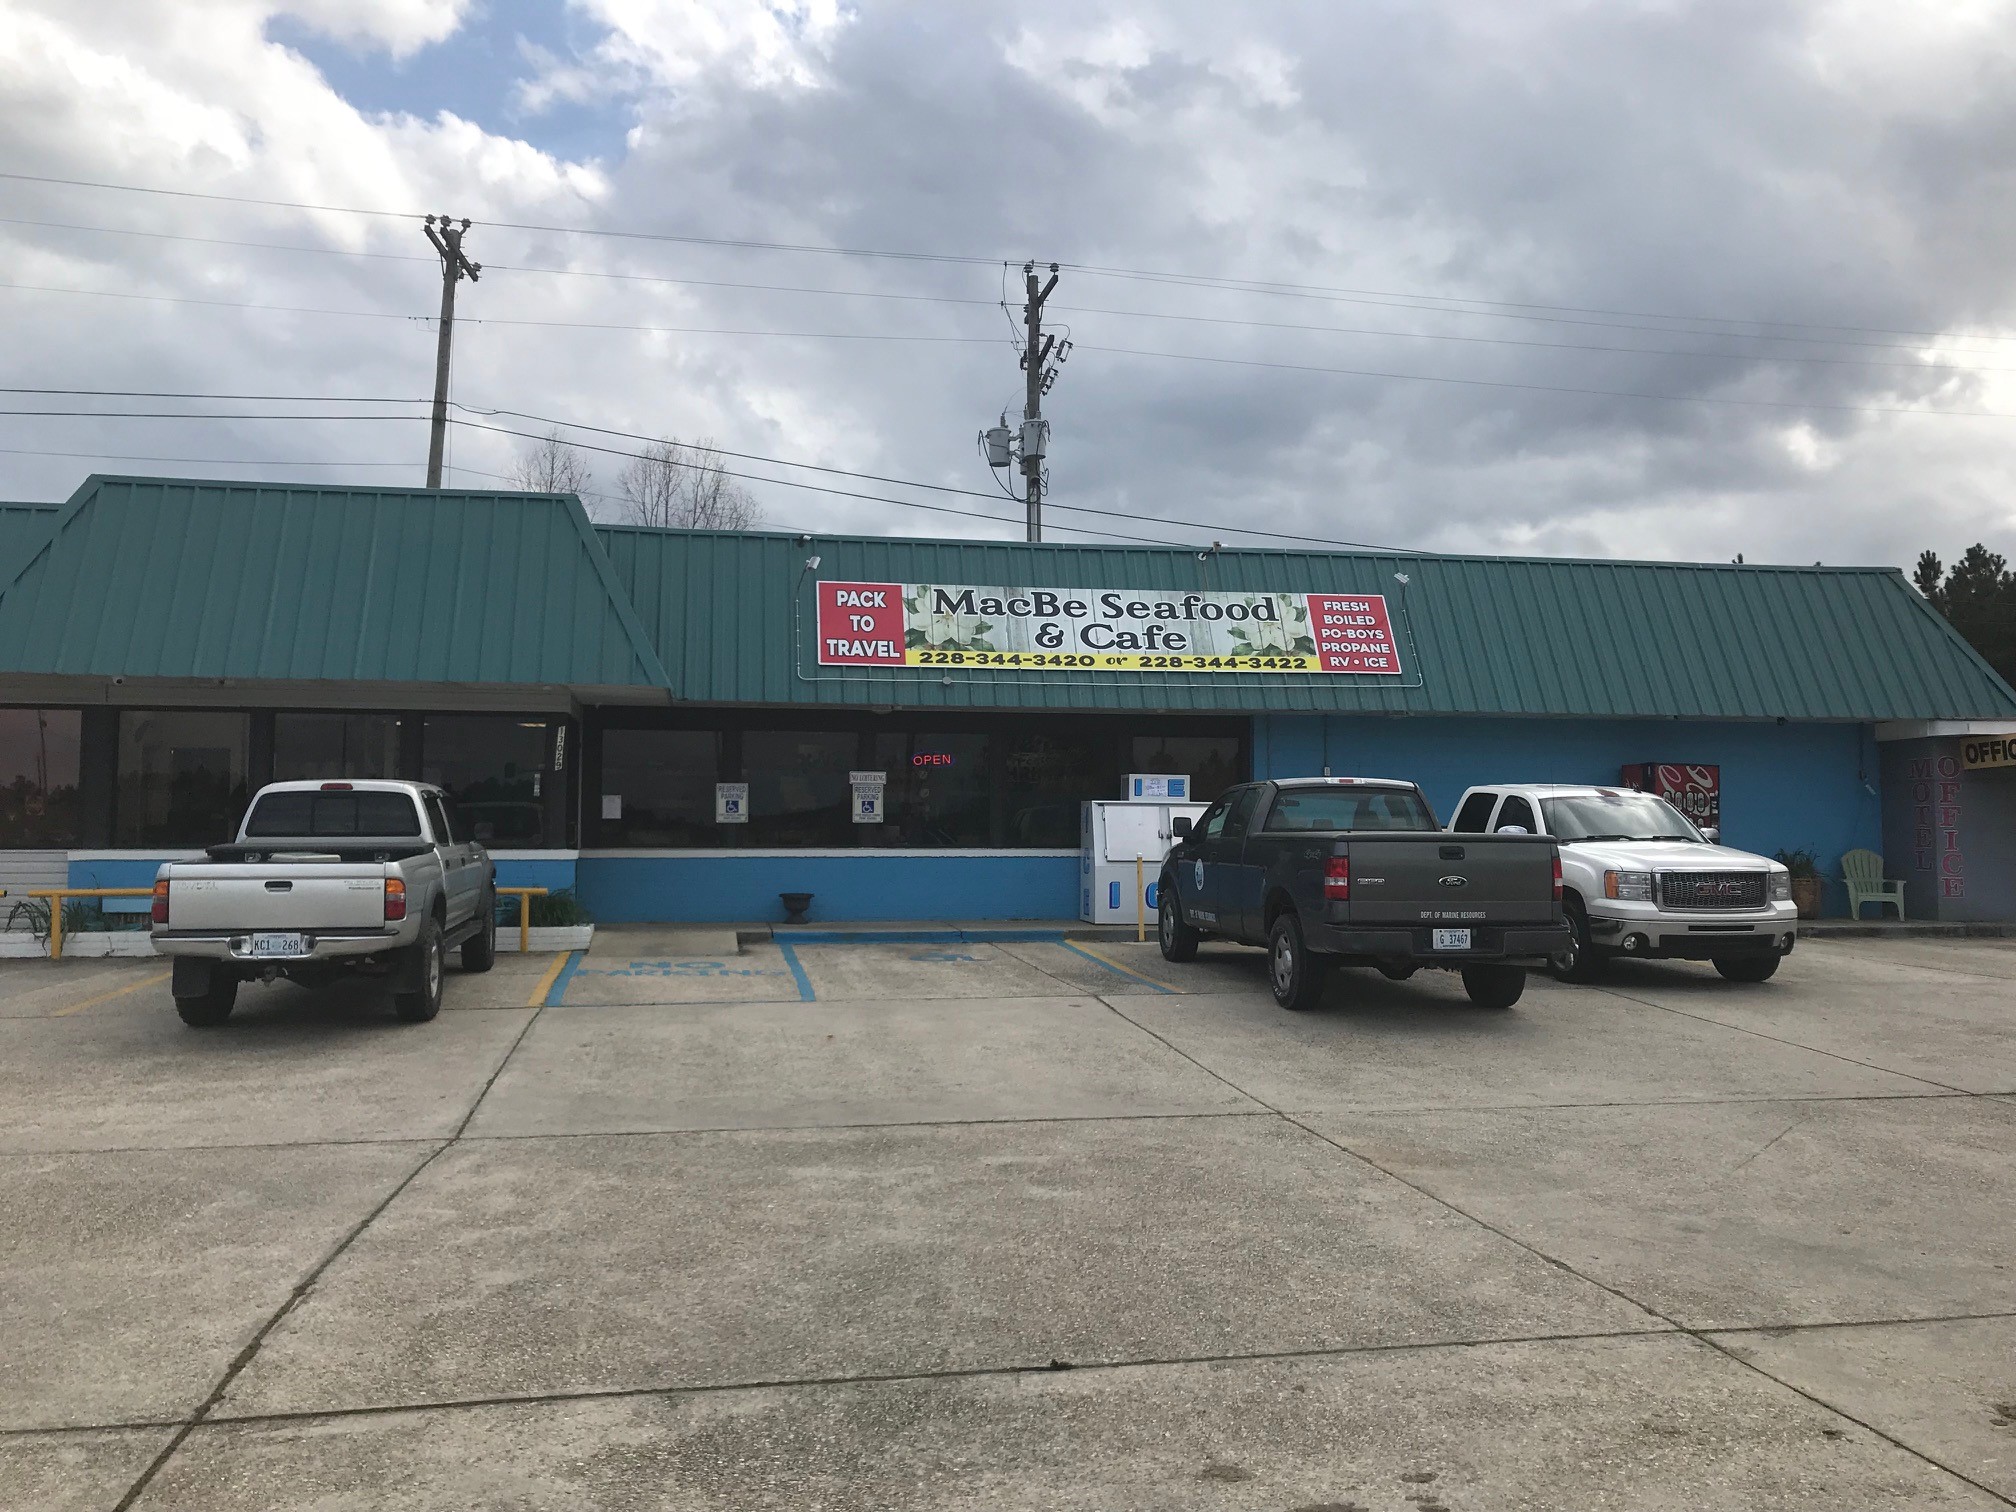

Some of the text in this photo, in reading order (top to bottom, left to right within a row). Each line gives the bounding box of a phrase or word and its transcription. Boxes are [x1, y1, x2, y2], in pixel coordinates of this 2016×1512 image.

[836, 590, 887, 608] PACK
[933, 588, 1280, 622] MacBe Seafood
[1323, 601, 1370, 612] FRESH
[849, 615, 875, 632] TO
[1323, 614, 1376, 626] BOILED
[1034, 622, 1188, 651] & Cafe
[1321, 628, 1385, 640] PO-BOYS
[826, 639, 900, 658] TRAVEL
[1322, 642, 1391, 655] PROPANE
[919, 652, 1308, 670] 228-344-3420 or 228-344-3422
[1330, 656, 1389, 669] RV ICE
[555, 727, 566, 770] 13029
[913, 754, 952, 766] OPEN
[1134, 778, 1186, 797] IE
[1908, 757, 1934, 872] MOTEL
[1937, 756, 1965, 898] OFFICE
[1445, 877, 1462, 887] Ford
[1696, 883, 1741, 896] GMC
[1421, 911, 1486, 919] DEPT. OF MARINE RESOURCES
[282, 939, 299, 950] 268
[1440, 934, 1468, 944] G 37467
[629, 961, 726, 969] NO
